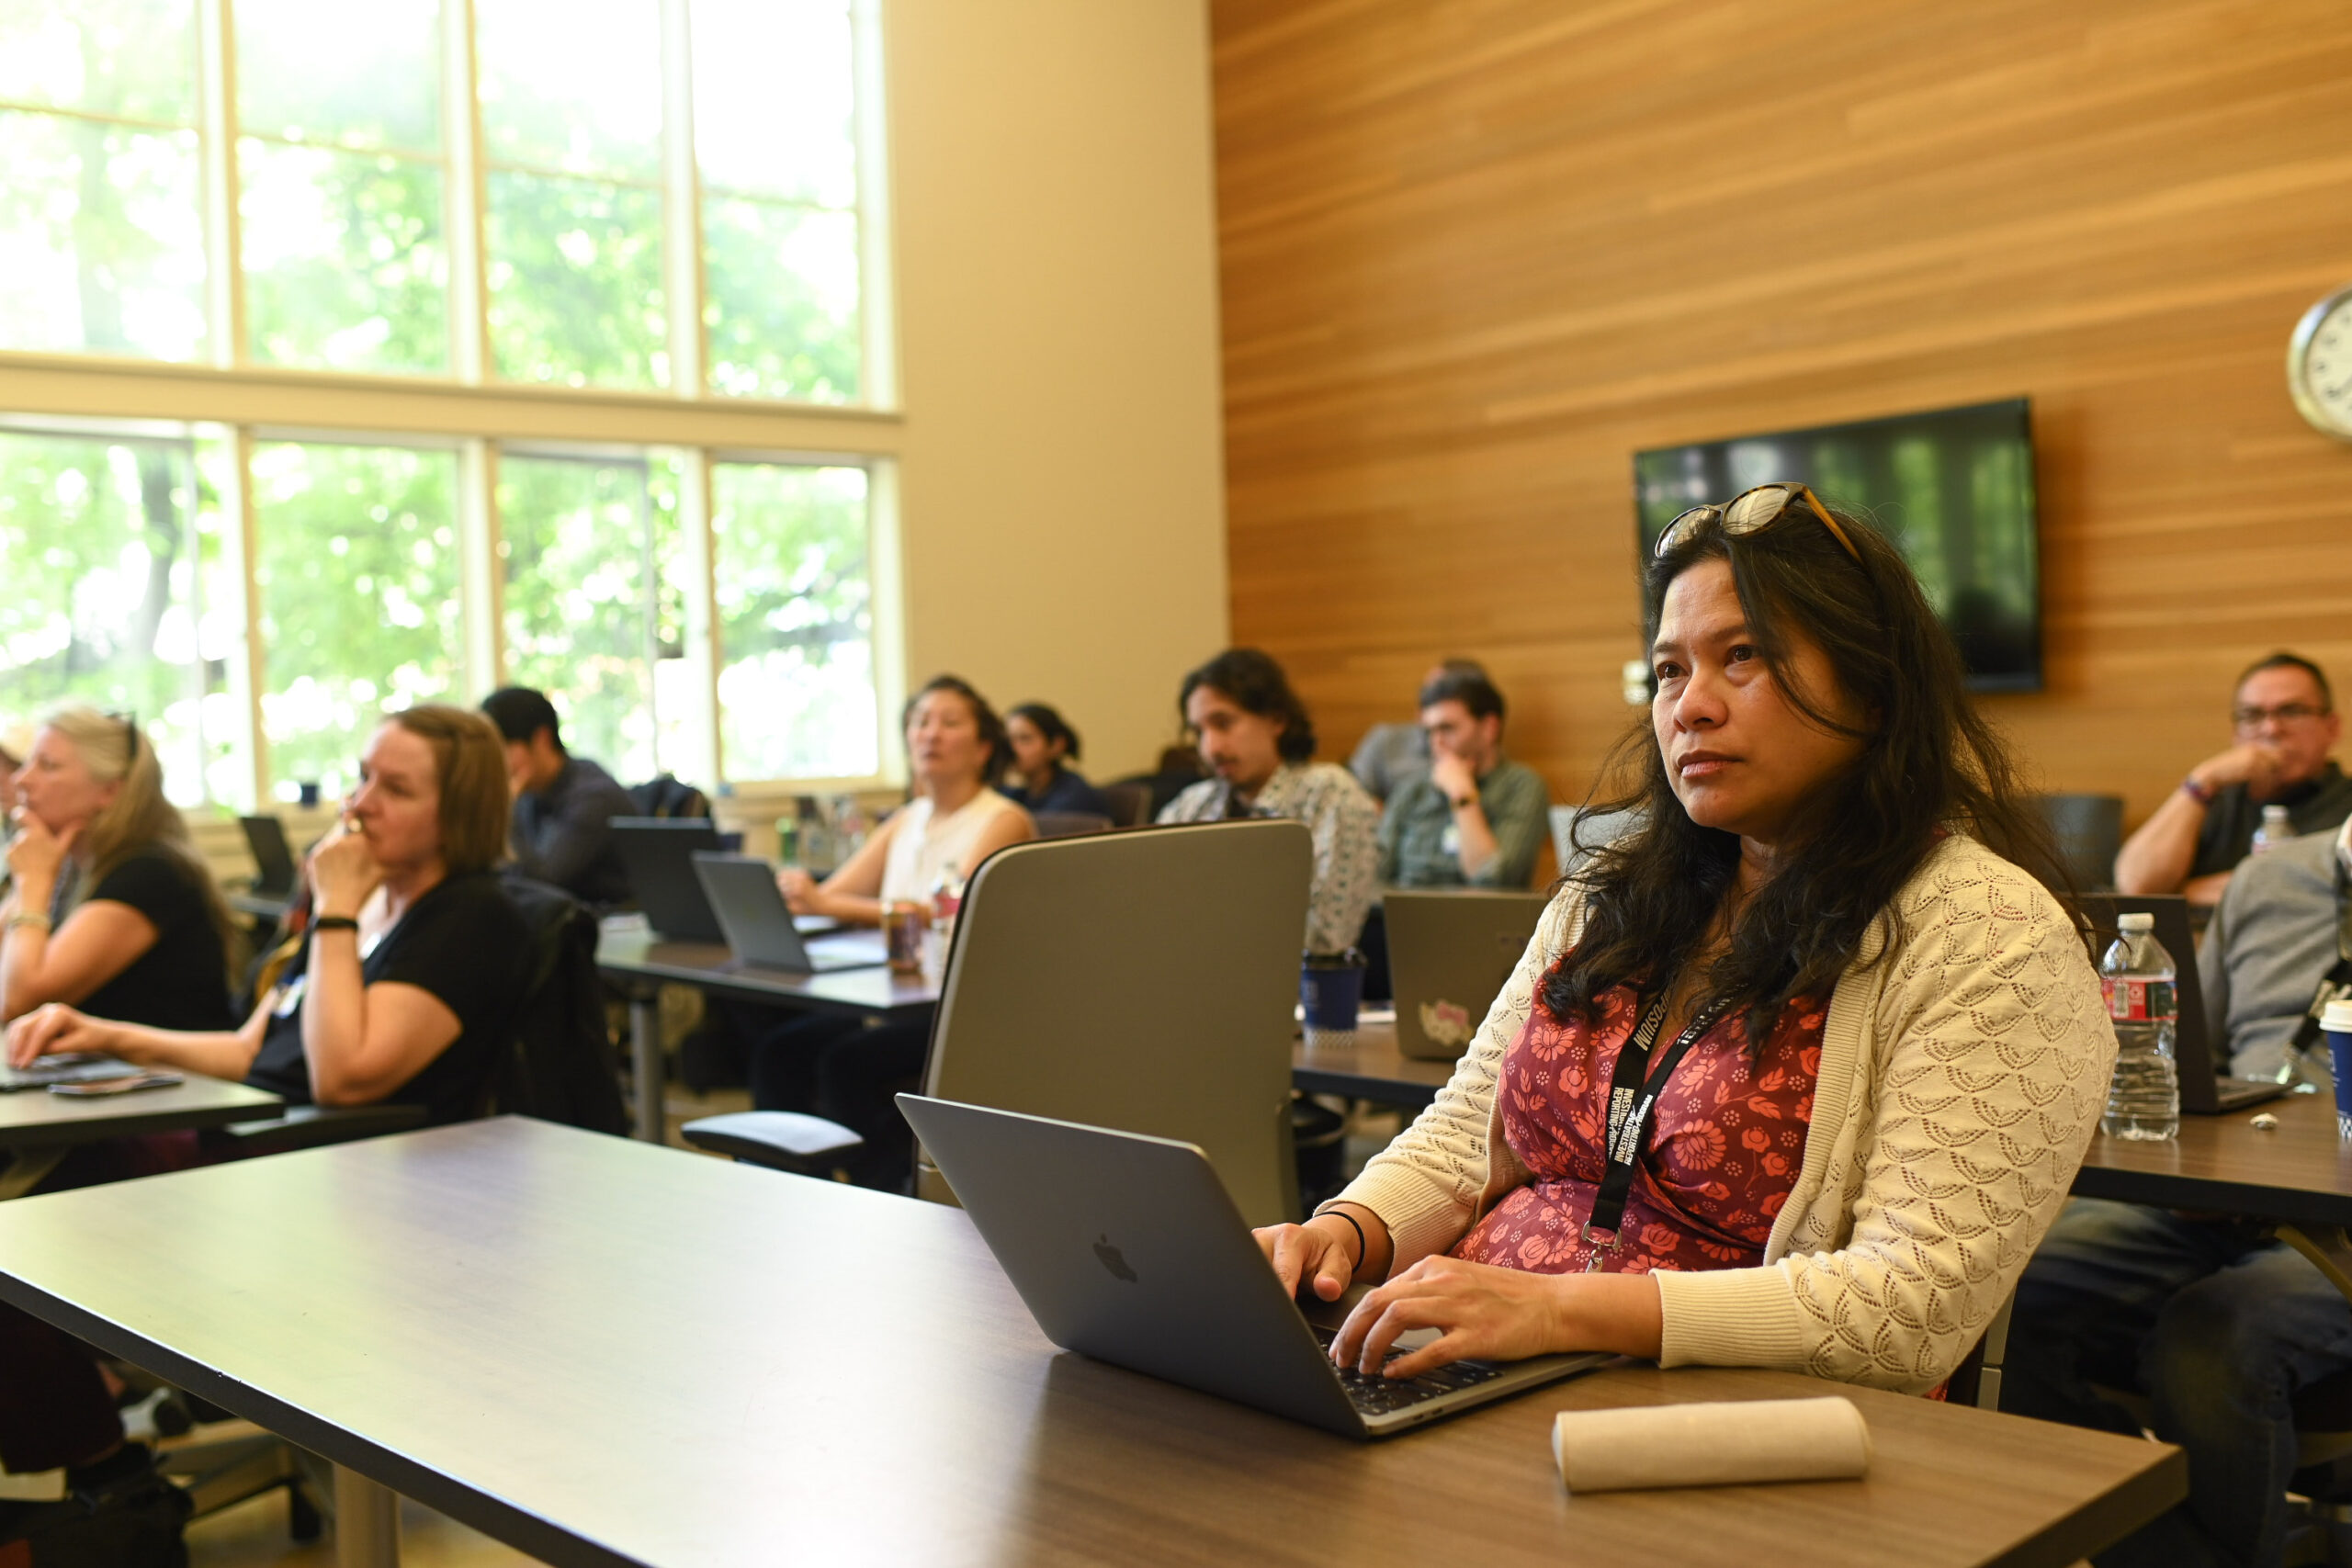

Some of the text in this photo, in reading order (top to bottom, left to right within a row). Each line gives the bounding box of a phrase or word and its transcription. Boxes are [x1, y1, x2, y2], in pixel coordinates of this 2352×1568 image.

[1634, 989, 1668, 1051] POSIUM
[1608, 1087, 1624, 1127] REPORTING
[1614, 1107, 1636, 1163] INVESTIGATIVE
[1623, 1094, 1654, 1166] REPORTING PROGRAM
